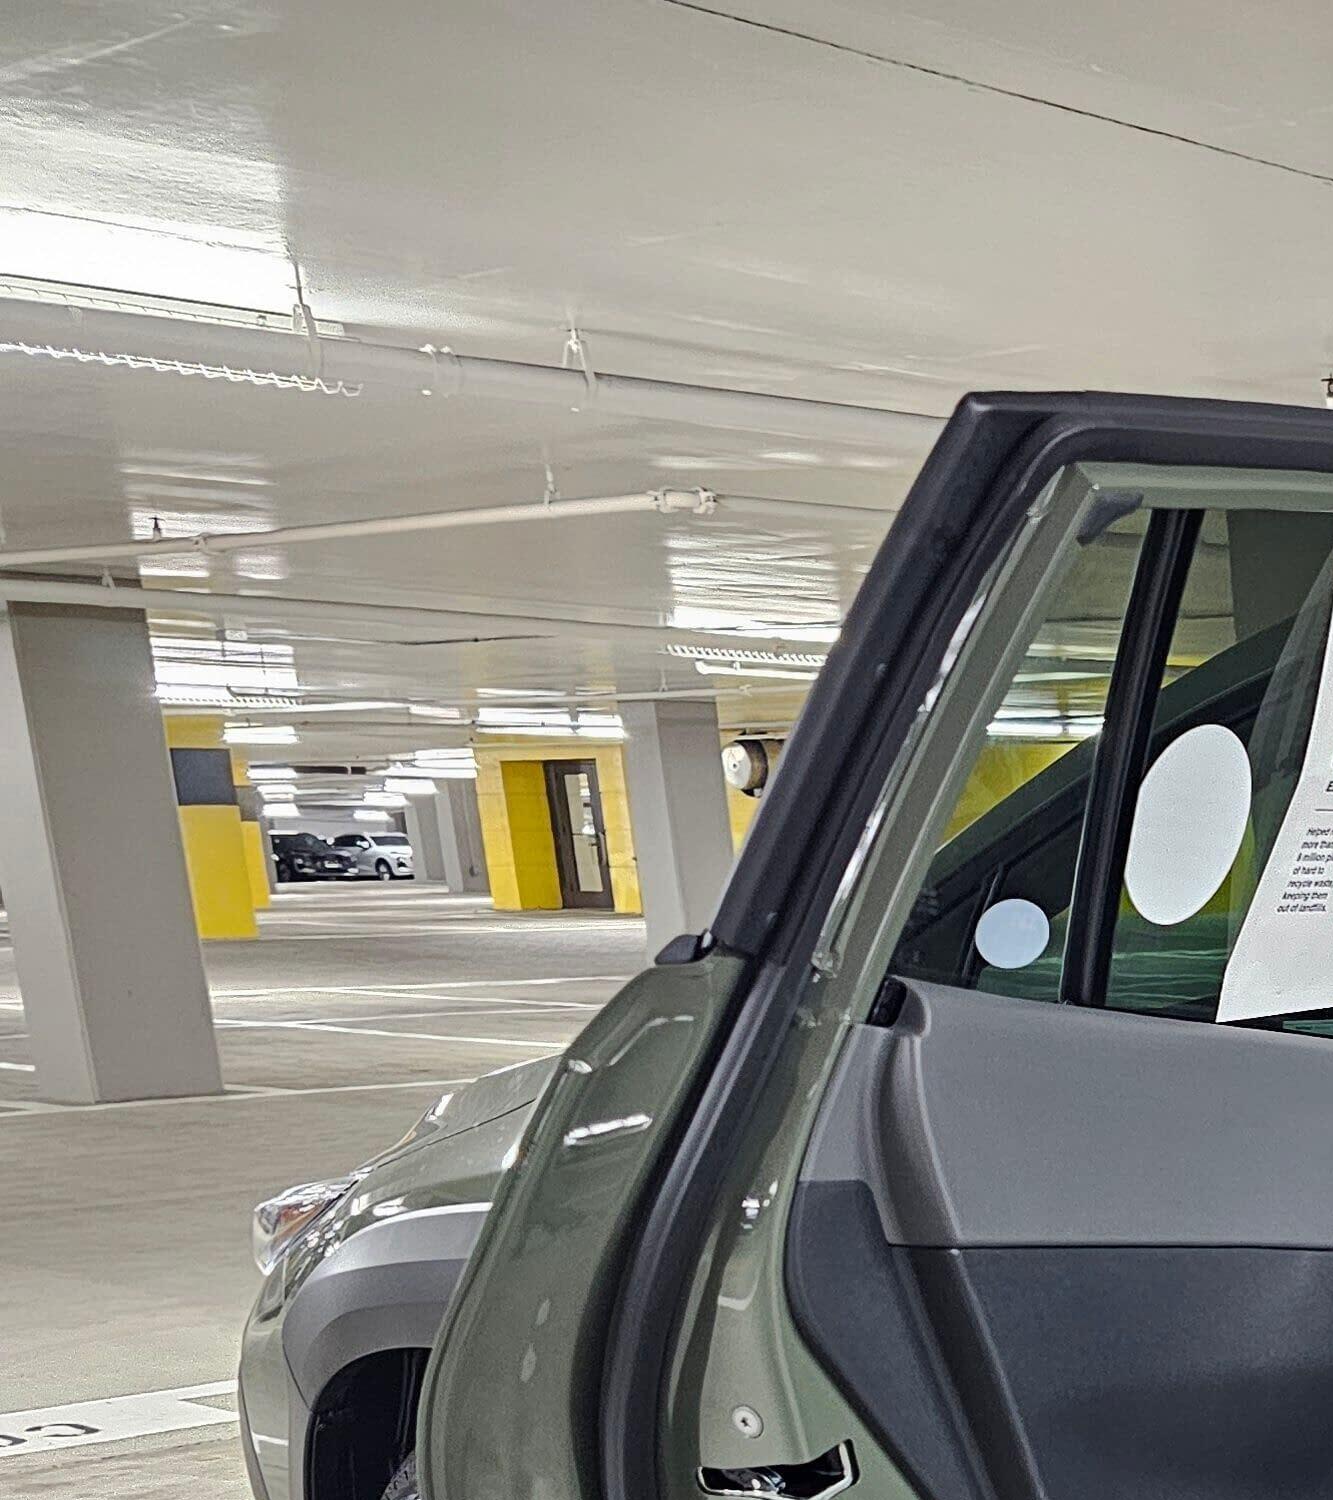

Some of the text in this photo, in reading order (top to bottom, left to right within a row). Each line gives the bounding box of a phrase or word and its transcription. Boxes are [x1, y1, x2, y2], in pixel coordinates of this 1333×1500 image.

[1307, 828, 1331, 837] Helped
[1301, 841, 1318, 849] more
[1304, 853, 1325, 861] million
[1293, 866, 1301, 874] of
[1287, 880, 1312, 888] recycle
[1282, 892, 1310, 901] keeping
[1277, 904, 1289, 912] out
[1290, 904, 1299, 912] of
